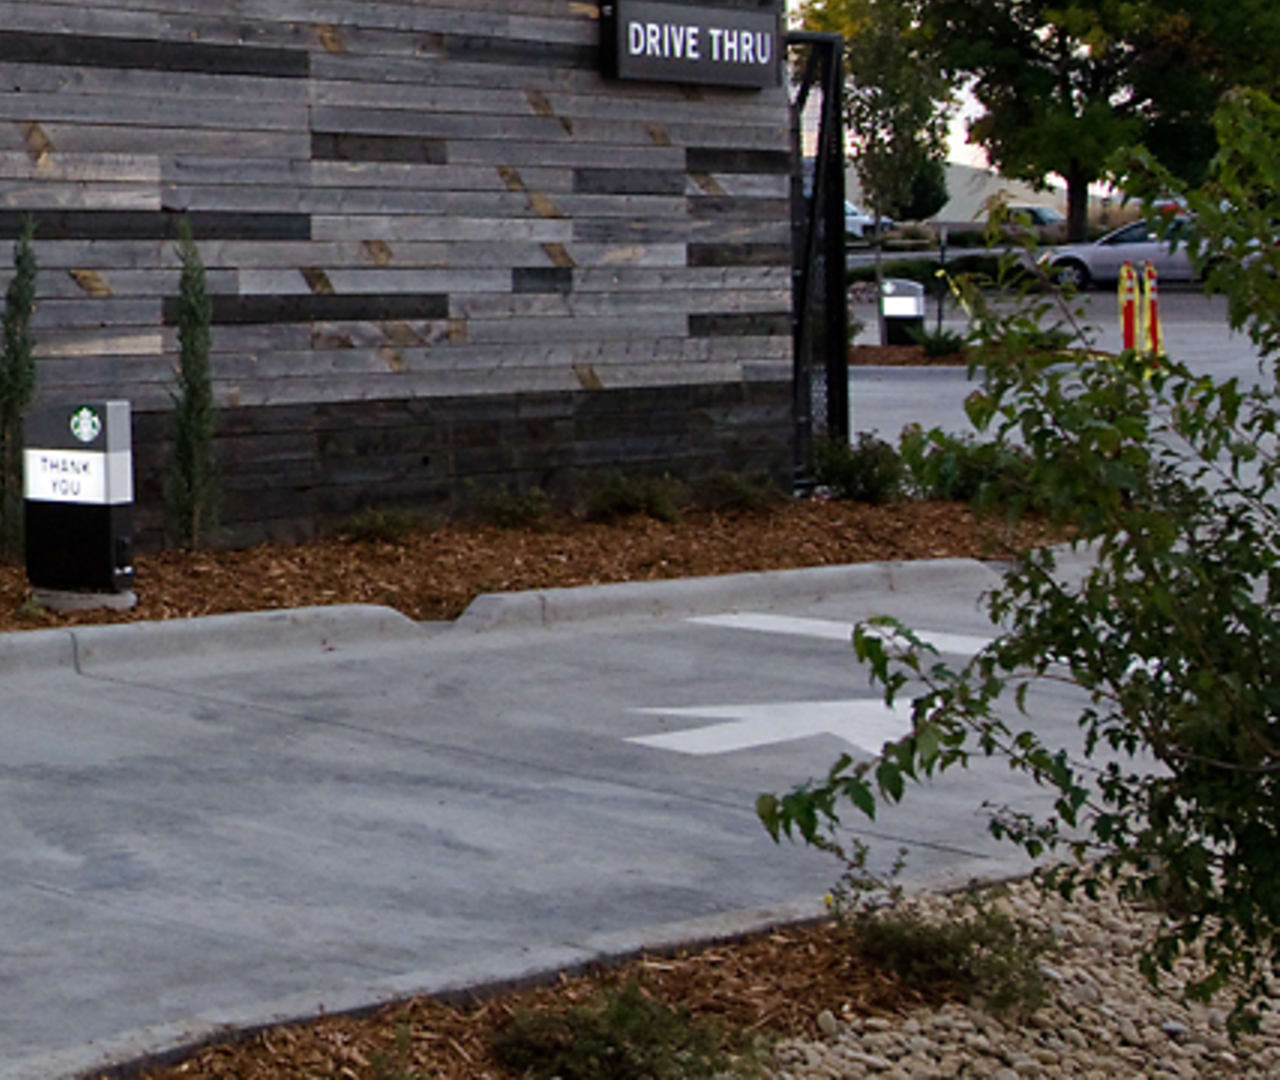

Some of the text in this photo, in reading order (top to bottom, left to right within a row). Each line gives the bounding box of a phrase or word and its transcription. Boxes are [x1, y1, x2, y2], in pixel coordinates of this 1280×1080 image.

[629, 22, 772, 65] DRIVE THRU
[40, 456, 91, 475] THANK
[51, 478, 81, 497] YOU
